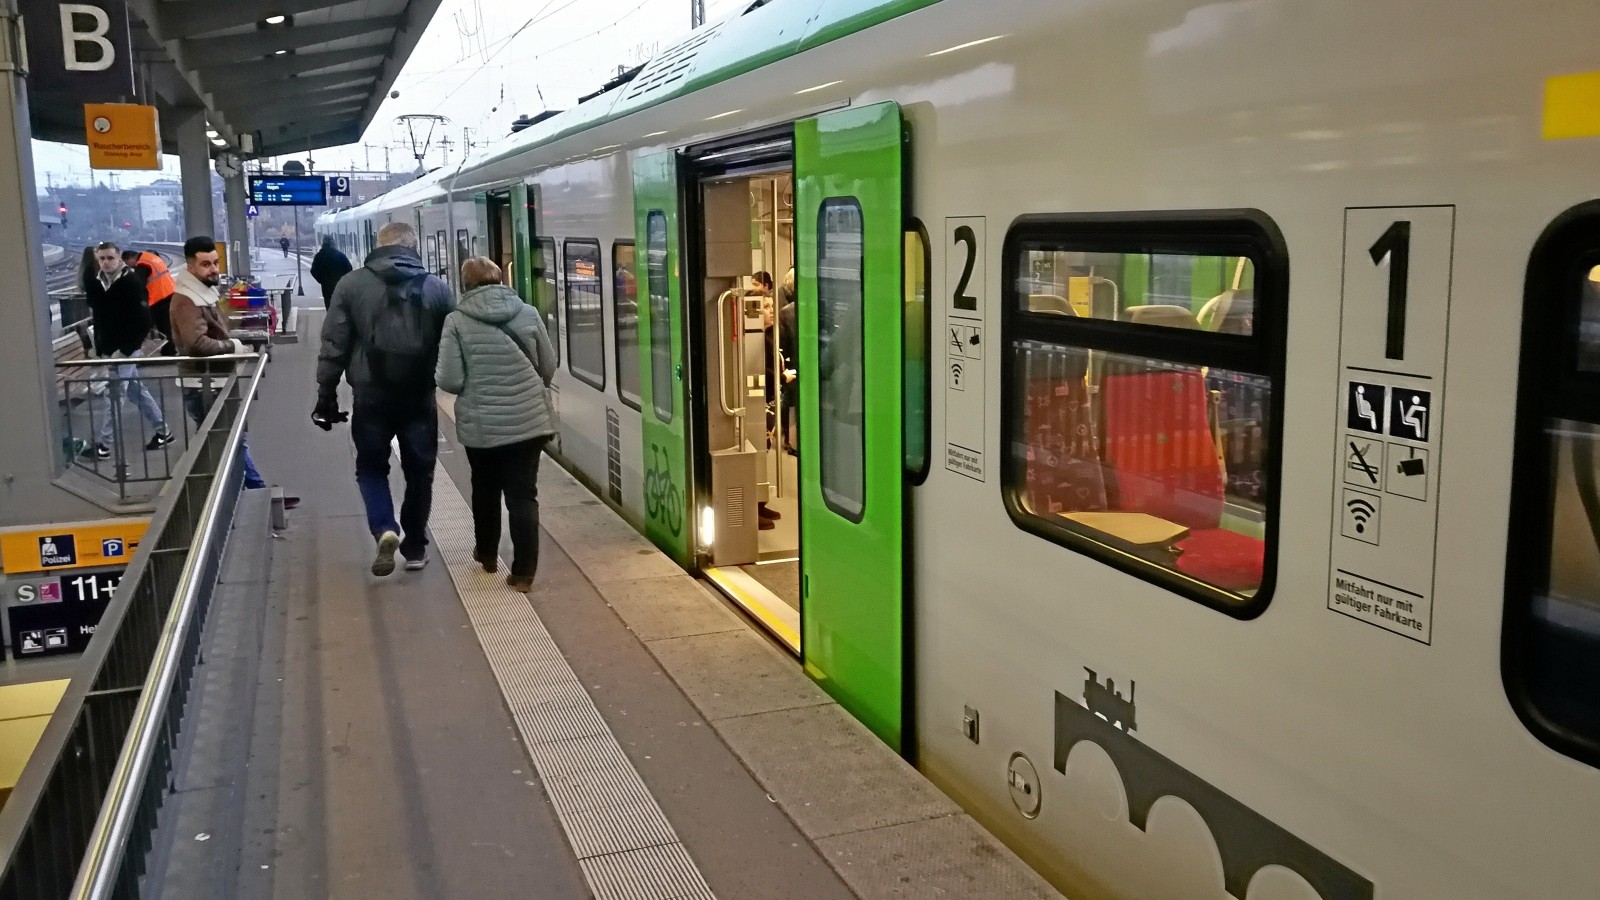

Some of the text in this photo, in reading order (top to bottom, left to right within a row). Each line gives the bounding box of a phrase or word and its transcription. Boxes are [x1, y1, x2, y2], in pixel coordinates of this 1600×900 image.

[59, 4, 115, 72] B
[93, 142, 151, 151] Raucherbereich
[337, 177, 347, 192] 9
[248, 205, 257, 214] A
[953, 225, 977, 311] 2
[1369, 220, 1411, 361] 1
[42, 555, 71, 565] Polizei
[108, 543, 118, 556] P
[18, 585, 35, 602] S
[71, 575, 122, 600] 11+
[1336, 578, 1414, 613] Mitfahrt nur mit
[1335, 593, 1422, 630] gültiger Fahrkarte
